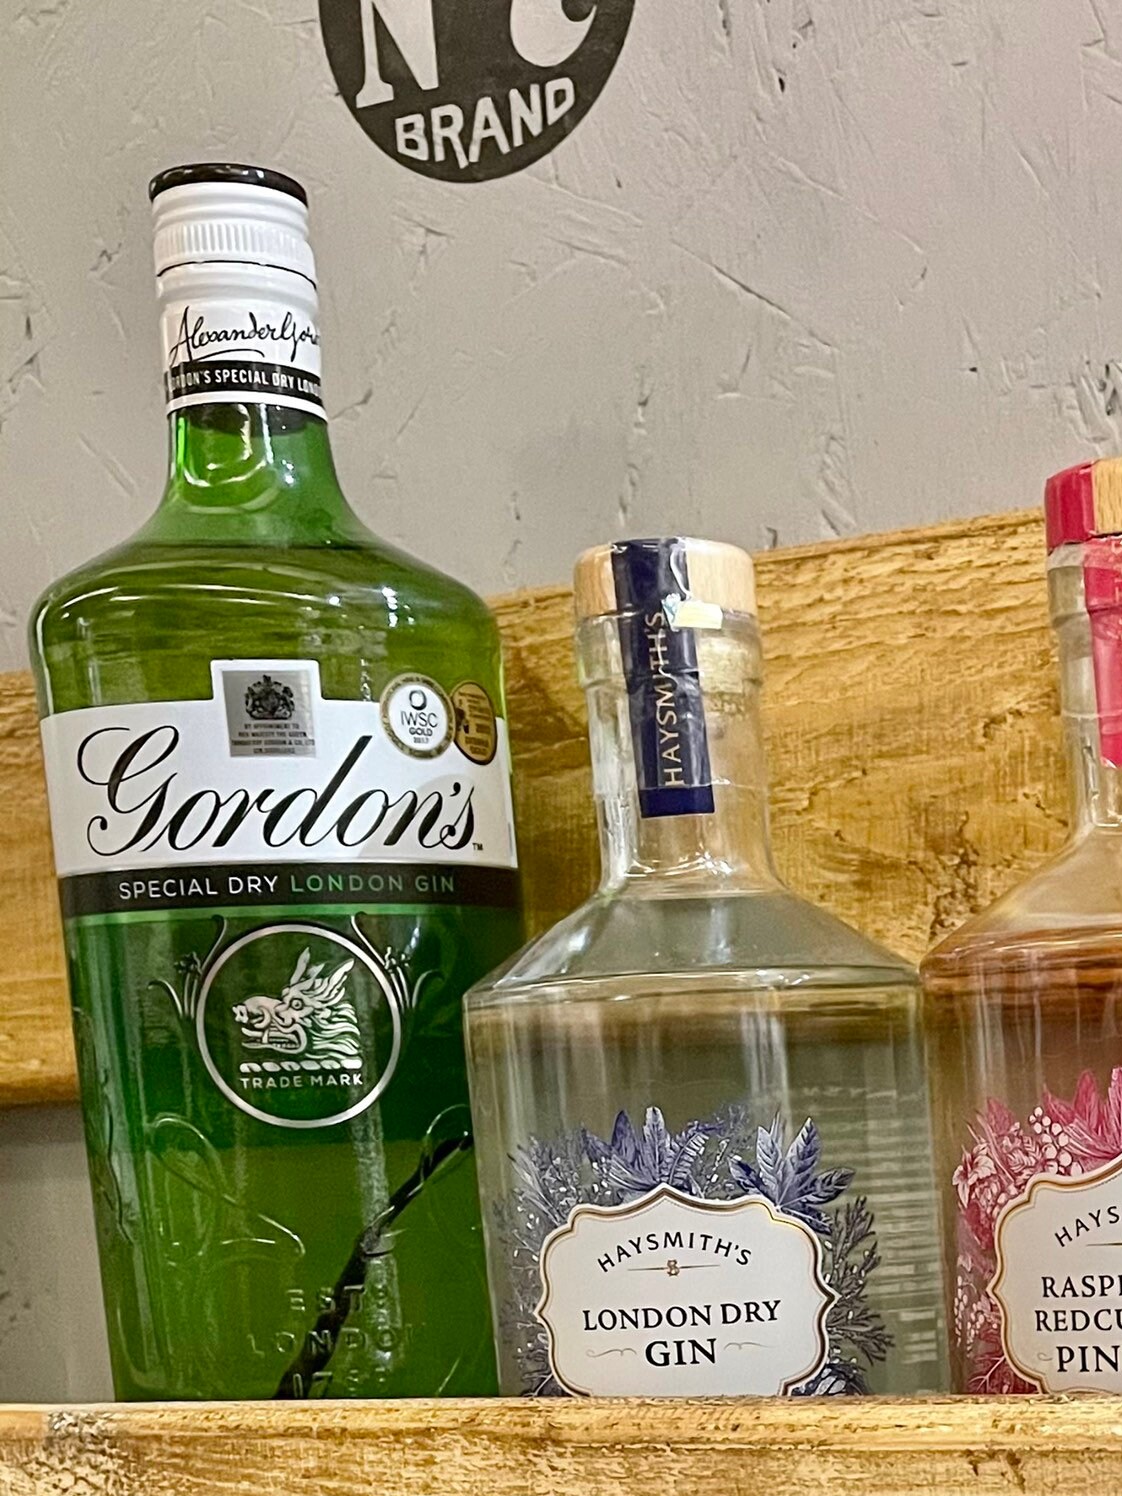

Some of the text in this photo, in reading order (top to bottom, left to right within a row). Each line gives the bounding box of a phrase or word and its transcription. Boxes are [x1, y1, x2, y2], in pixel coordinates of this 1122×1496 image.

[395, 77, 575, 169] BRAND
[214, 368, 269, 385] SPECIAL
[272, 372, 294, 389] DRY
[400, 711, 439, 728] IWSC
[409, 727, 433, 737] GOLD
[77, 724, 476, 857] Gordon's
[119, 874, 455, 900] SPECIAL DRY LONDON GIN
[240, 1073, 363, 1090] TRADE MARK
[598, 1231, 752, 1273] HAYSMITH'S
[582, 1300, 781, 1331] LONDON DRY
[645, 1338, 717, 1368] GIN
